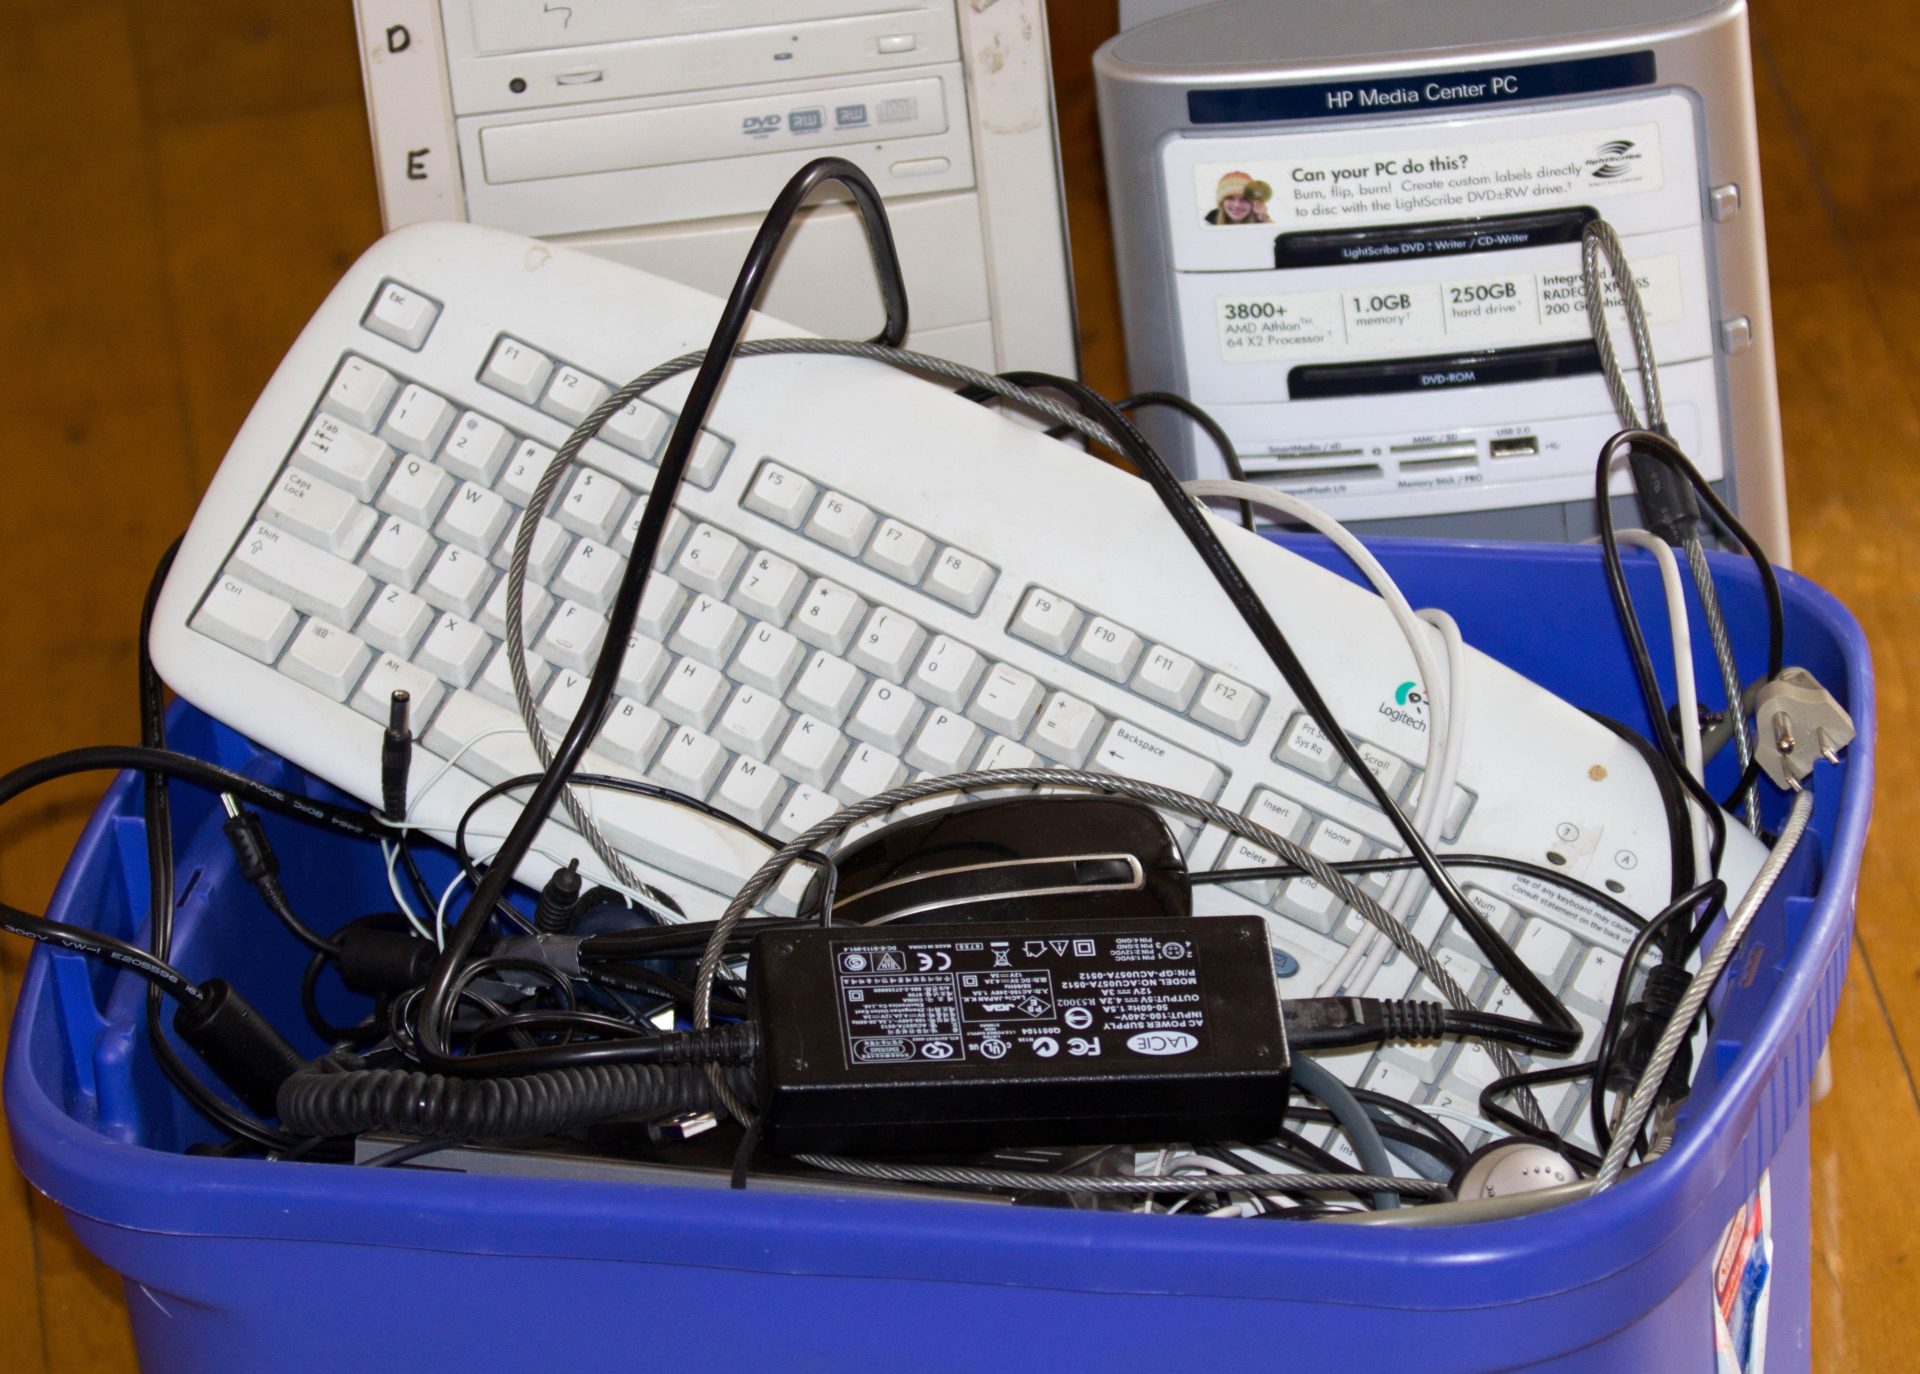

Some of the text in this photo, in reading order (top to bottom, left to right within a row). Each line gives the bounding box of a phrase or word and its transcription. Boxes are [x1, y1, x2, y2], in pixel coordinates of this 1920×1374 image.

[386, 24, 411, 53] D
[1327, 75, 1519, 109] HP Media Center PC
[742, 114, 781, 129] DVD
[407, 148, 431, 180] E
[1292, 154, 1468, 183] Can your PC do this?
[1331, 185, 1354, 199] flip,
[1401, 179, 1444, 192] Create
[1448, 175, 1491, 188] custom
[1495, 166, 1534, 183] labels
[1536, 162, 1583, 180] directly
[1295, 206, 1309, 217] to
[1312, 203, 1338, 216] disc
[1342, 201, 1368, 214] with
[1371, 199, 1392, 212] the
[1395, 192, 1463, 213] LightScribe
[1343, 233, 1529, 259] LightScribe DVD Writer CD-Writer
[389, 291, 406, 305] Esc
[1451, 282, 1517, 304] 250GB
[1224, 302, 1287, 320] 3800+
[1353, 294, 1411, 313] 1.0GB
[1545, 303, 1570, 316] 200
[1452, 305, 1481, 318] hard
[1225, 323, 1257, 334] AMD
[1227, 336, 1243, 347] 64
[1247, 336, 1263, 347] X2
[504, 345, 519, 361] F1
[562, 373, 578, 389] F2
[1422, 371, 1476, 386] DVD-ROM
[321, 419, 338, 435] Tab
[407, 460, 420, 476] Q
[289, 472, 313, 491] Caps
[768, 471, 784, 486] F5
[1398, 479, 1433, 489] Memory
[283, 482, 305, 499] Lock
[466, 488, 482, 504] W
[827, 498, 843, 515] F6
[257, 525, 281, 543] Shift
[390, 523, 401, 536] A
[886, 527, 903, 542] F7
[448, 548, 460, 562] S
[582, 545, 594, 559] R
[945, 556, 962, 571] F8
[223, 581, 243, 596] Ctrl
[386, 590, 398, 604] Z
[565, 607, 577, 619] F
[700, 601, 712, 614] Y
[809, 604, 819, 617] 8
[1036, 598, 1052, 613] F9
[445, 618, 458, 633] X
[759, 629, 771, 643] U
[868, 632, 878, 644] 9
[1094, 626, 1116, 643] F10
[385, 657, 400, 673] Alt
[1154, 655, 1173, 671] F11
[683, 664, 697, 678] H
[565, 676, 577, 690] V
[742, 693, 753, 705] J
[1214, 683, 1237, 700] F12
[623, 705, 635, 718] B
[1379, 702, 1427, 732] Logitech
[801, 720, 814, 734] K
[937, 715, 949, 728] P
[1302, 722, 1315, 734] Prt
[681, 732, 695, 747] N
[1117, 727, 1166, 758] Backspace
[1295, 736, 1322, 756] Sys Rq
[861, 750, 869, 763] L
[1364, 752, 1390, 769] Scroll
[740, 762, 756, 777] M
[249, 781, 285, 802] 300V
[1263, 799, 1289, 818] Insert
[1324, 827, 1352, 846] Home
[1239, 846, 1268, 865] Delete
[1474, 896, 1496, 912] Num
[1517, 875, 1531, 885] use
[1541, 887, 1555, 898] any
[1557, 893, 1592, 915] keyboard
[1593, 912, 1610, 925] may
[1611, 920, 1633, 935] cause
[1512, 884, 1539, 901] Consult
[1541, 898, 1578, 921] statement
[1579, 917, 1589, 925] on
[1590, 919, 1603, 932] the
[1603, 926, 1621, 941] back
[1622, 936, 1631, 945] of
[3, 925, 48, 941] 300V
[1079, 969, 1196, 980] P/N:GP-ACU057A-0512
[1061, 977, 1197, 989] MODEL NO:ACU057A-0512
[1133, 987, 1152, 995] 12V
[1140, 994, 1200, 1003] OUTPUT:5V
[1056, 998, 1096, 1007] R53002
[1102, 1004, 1168, 1013] 50-60Hz 1.5A
[1103, 1021, 1145, 1030] SUPPLY
[1146, 1020, 1186, 1028] POWER
[1339, 1143, 1353, 1157] Ins
